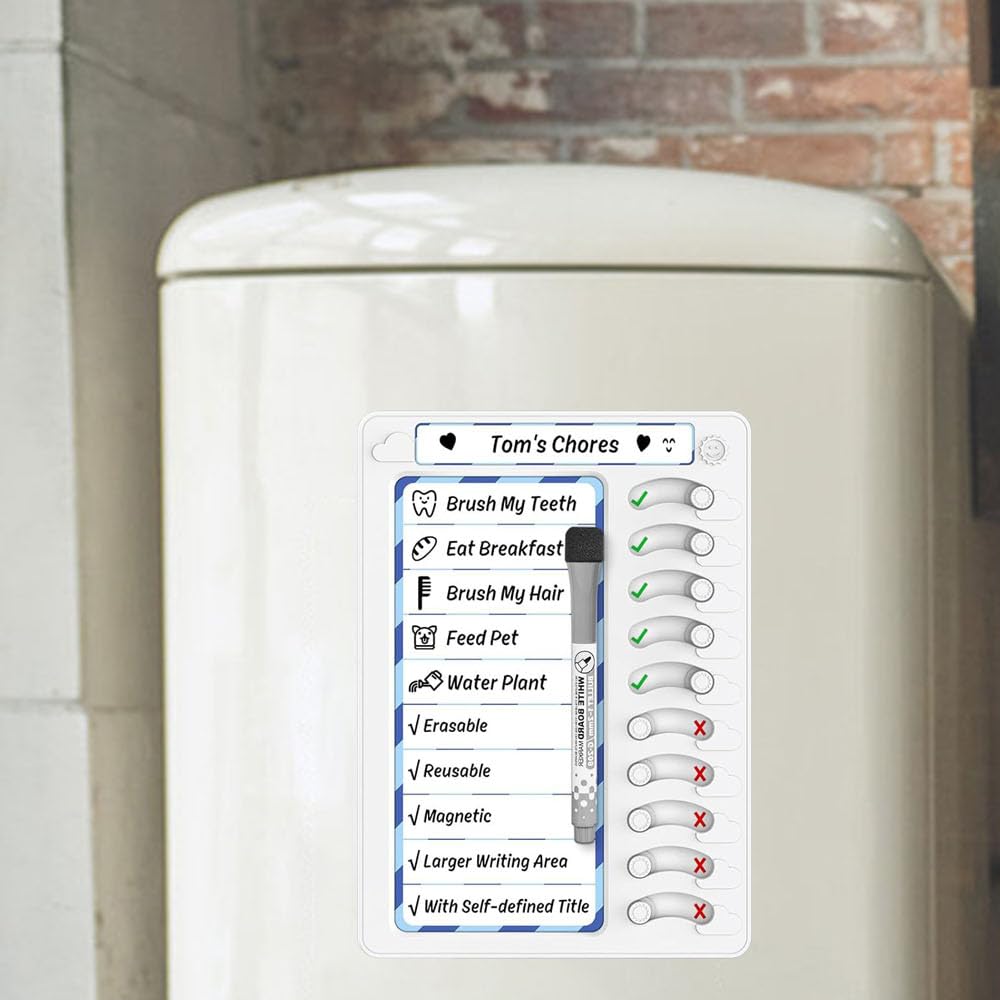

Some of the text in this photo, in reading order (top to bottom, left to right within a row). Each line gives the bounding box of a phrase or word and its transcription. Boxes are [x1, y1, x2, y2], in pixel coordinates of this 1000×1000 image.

[491, 434, 620, 454] Tom's Chores
[446, 495, 577, 516] Brush My Teeth
[446, 539, 564, 557] Eat Breakfast
[446, 584, 565, 606] Brush My Hair
[446, 629, 520, 646] Feed Pet
[447, 673, 548, 691] Water Plant
[423, 717, 488, 733] Erasable
[423, 762, 491, 778] Reusable
[423, 807, 492, 827] Magnetic
[423, 853, 568, 872] Larger Writing Area
[424, 898, 590, 914] With Self-defined Title
